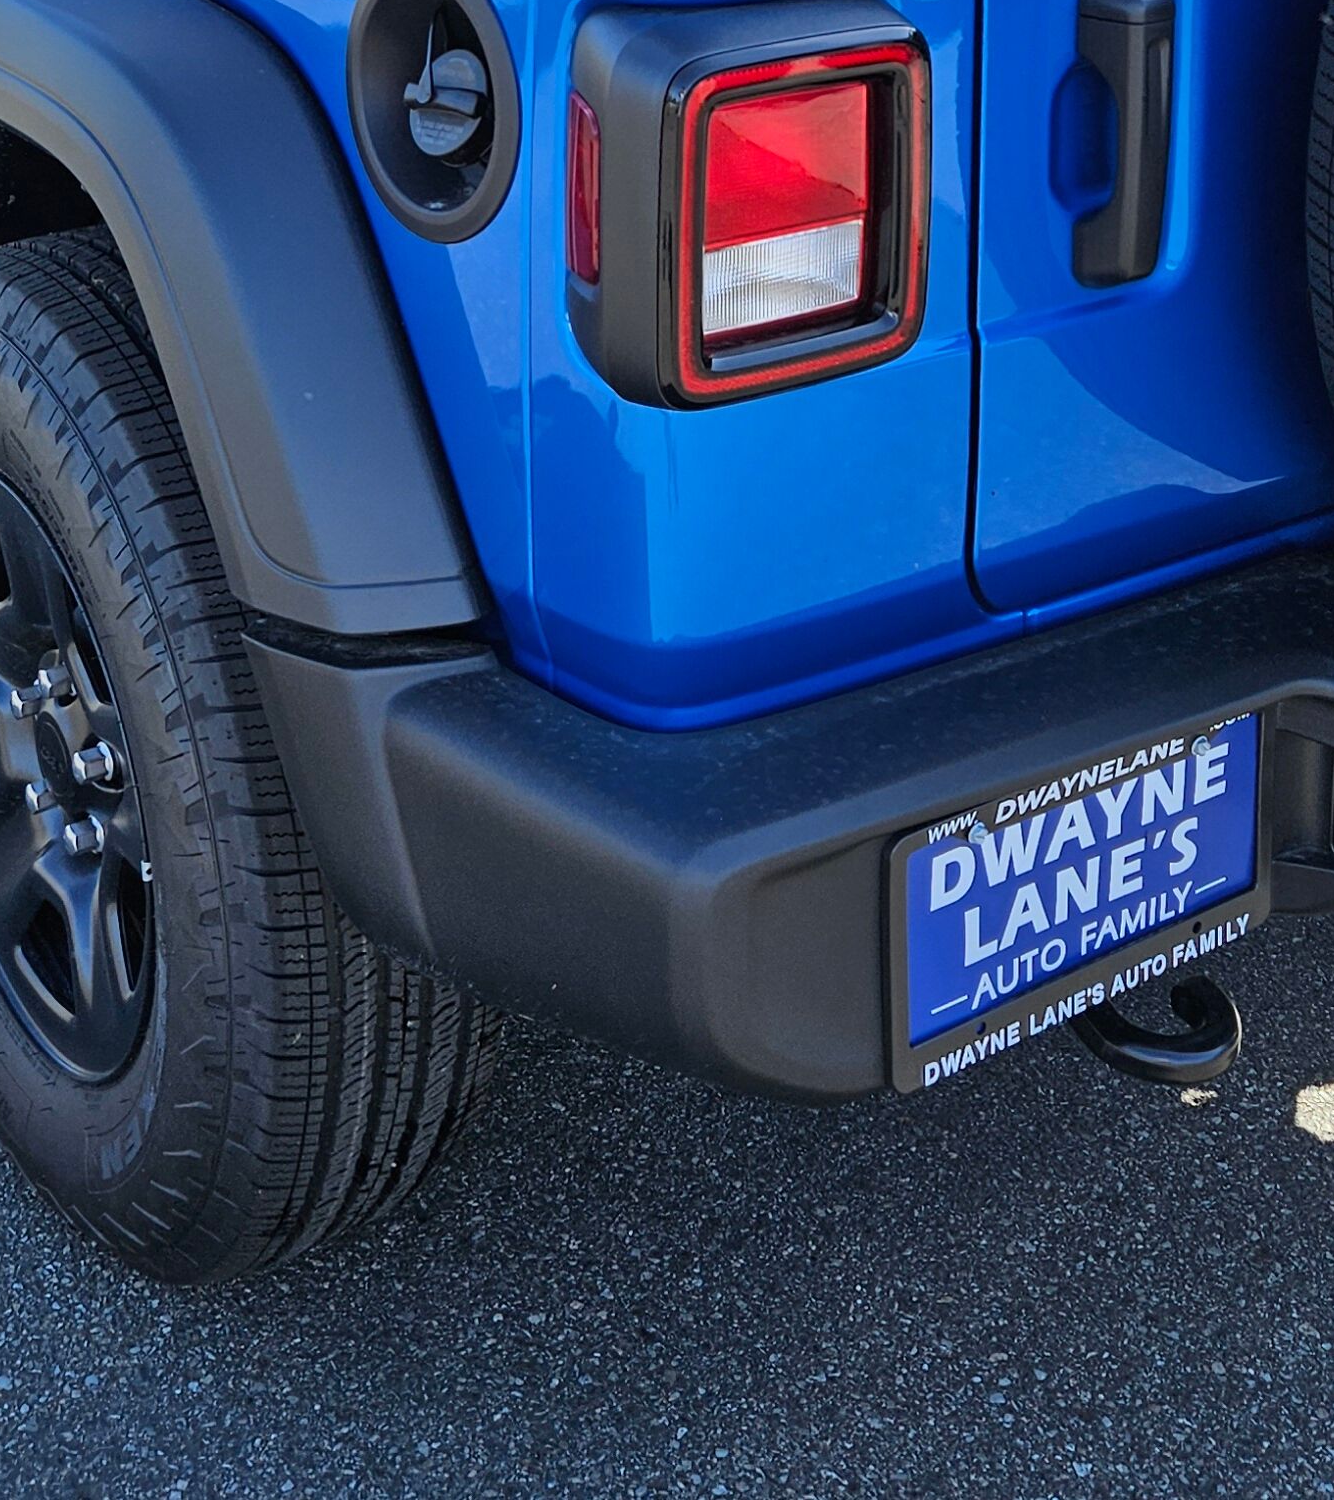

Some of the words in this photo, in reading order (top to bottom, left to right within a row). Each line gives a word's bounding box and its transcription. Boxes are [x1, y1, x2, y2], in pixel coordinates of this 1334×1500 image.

[929, 742, 1230, 913] DWAYNE
[994, 737, 1185, 826] DWAYNELANE
[963, 817, 1200, 968] LANE'S
[970, 937, 1067, 1011] AUTO
[1080, 880, 1194, 957] FAMILY
[923, 1025, 1022, 1088] DWAYNE
[1028, 983, 1106, 1037] LANE'S
[1110, 953, 1168, 998] AUTO
[1171, 913, 1251, 969] FAMILY
